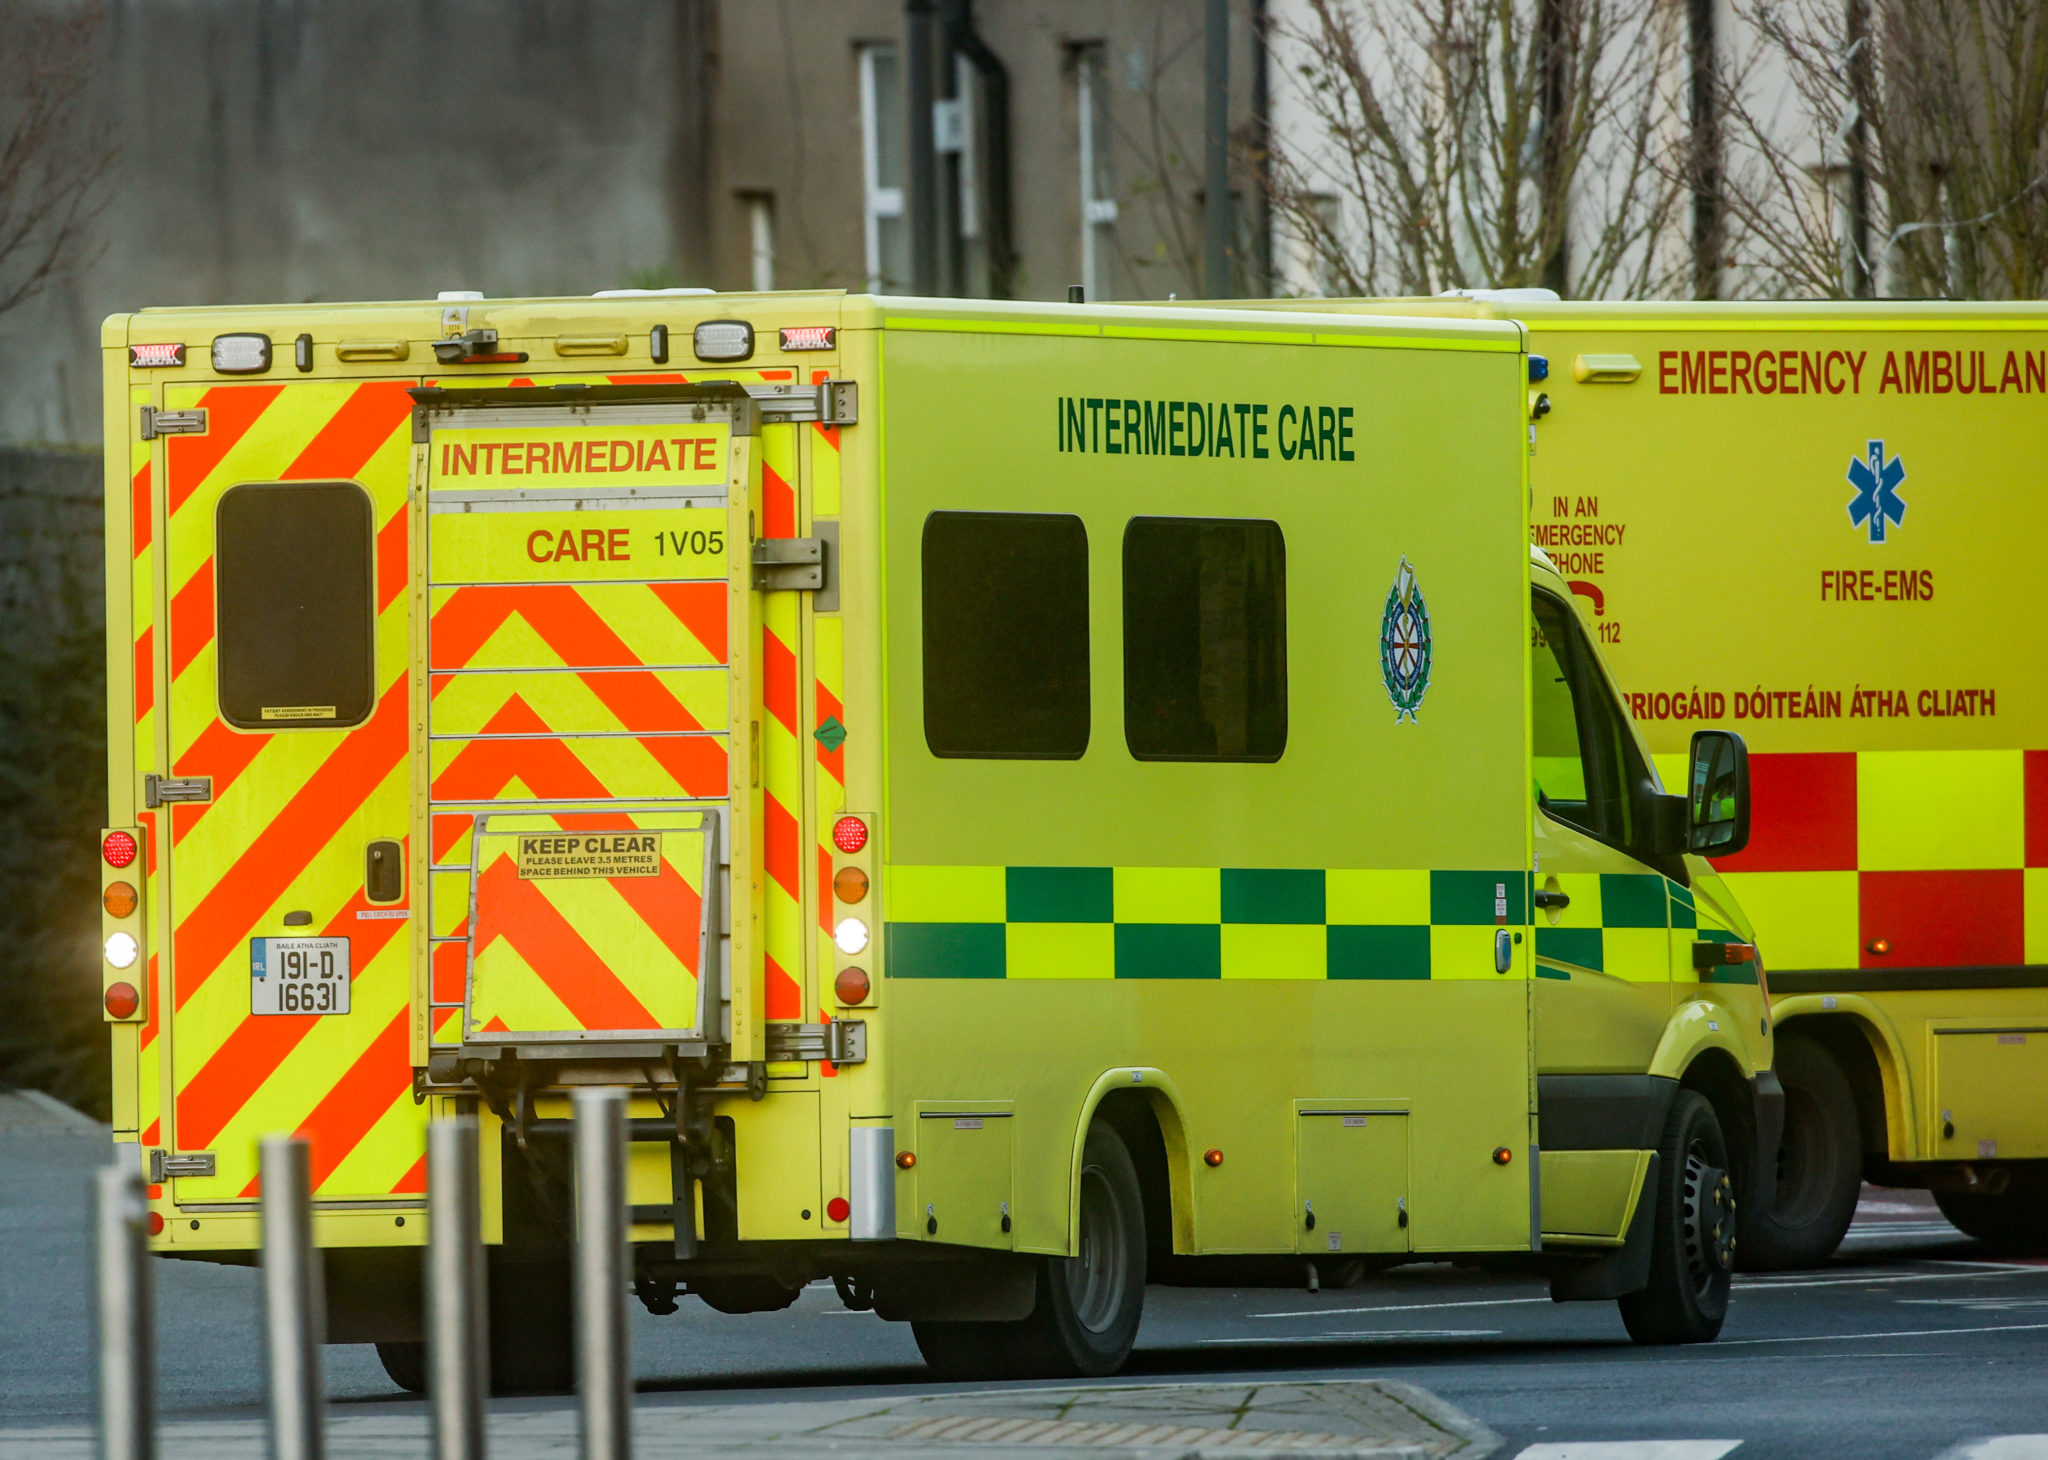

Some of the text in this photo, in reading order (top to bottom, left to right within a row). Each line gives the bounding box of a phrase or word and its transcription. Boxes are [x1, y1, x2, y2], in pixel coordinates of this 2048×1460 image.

[1658, 349, 2047, 395] EMERGENCY AMBULAN
[1058, 396, 1355, 461] INTERMEDIATE CARE
[441, 438, 717, 476] INTERMEDIATE
[1553, 496, 1598, 517] IN AN
[526, 528, 724, 563] CARE 1V05
[1821, 570, 1934, 601] FIRE-EMS
[1598, 622, 1621, 643] 112
[1734, 684, 1841, 719] DÓITEÁIN
[1849, 684, 1910, 718] ÁTHA
[1916, 689, 1995, 717] CLIATH
[523, 837, 656, 855] KEEP CLEAR
[526, 855, 653, 865] PLEASE LEAVE 3.5 METRES
[520, 866, 658, 876] SPACE BEHIND THIS VEHICLE
[252, 962, 266, 971] IRL
[280, 951, 334, 979] 191-D
[279, 982, 336, 1011] 16631
